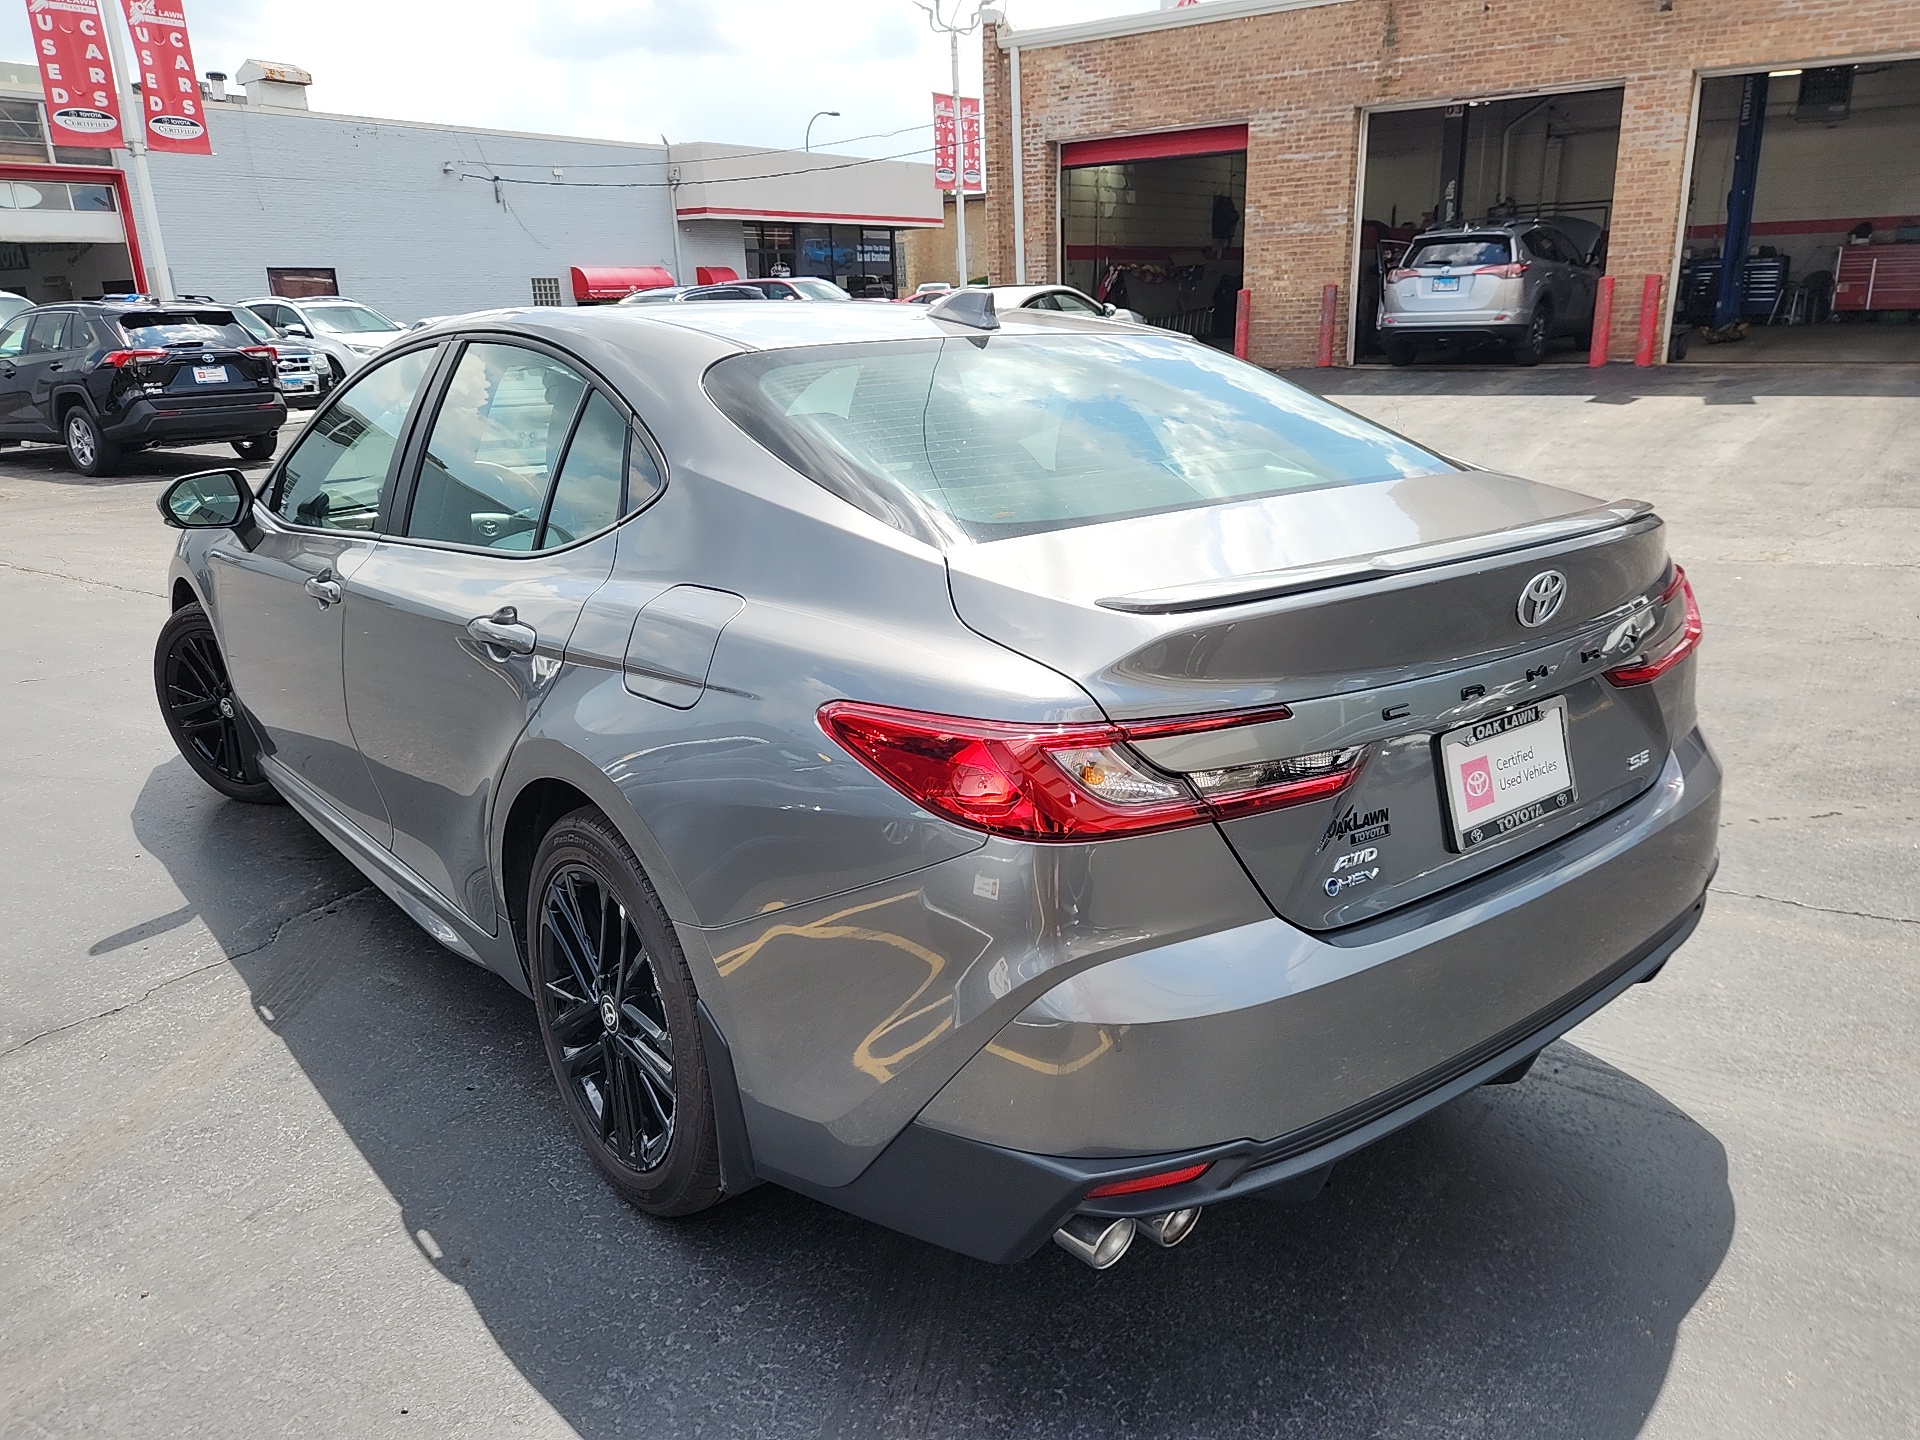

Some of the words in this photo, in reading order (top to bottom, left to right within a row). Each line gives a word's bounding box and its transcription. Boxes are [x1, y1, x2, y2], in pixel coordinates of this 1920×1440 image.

[158, 9, 183, 19] LAWN
[36, 14, 69, 104] USED
[79, 20, 109, 107] CARS
[135, 26, 163, 111] USED
[169, 32, 196, 115] CARS
[63, 119, 110, 128] CERTIFIED
[79, 111, 103, 119] TOYOTA
[1475, 720, 1503, 740] OAK
[1503, 708, 1537, 730] LAWN
[1496, 745, 1535, 771] Certified
[1627, 749, 1650, 771] SE
[1499, 771, 1523, 791] Used
[1523, 759, 1558, 783] Vehicles
[1496, 803, 1545, 832] TOYOTA
[1354, 825, 1386, 843] TOYOTA
